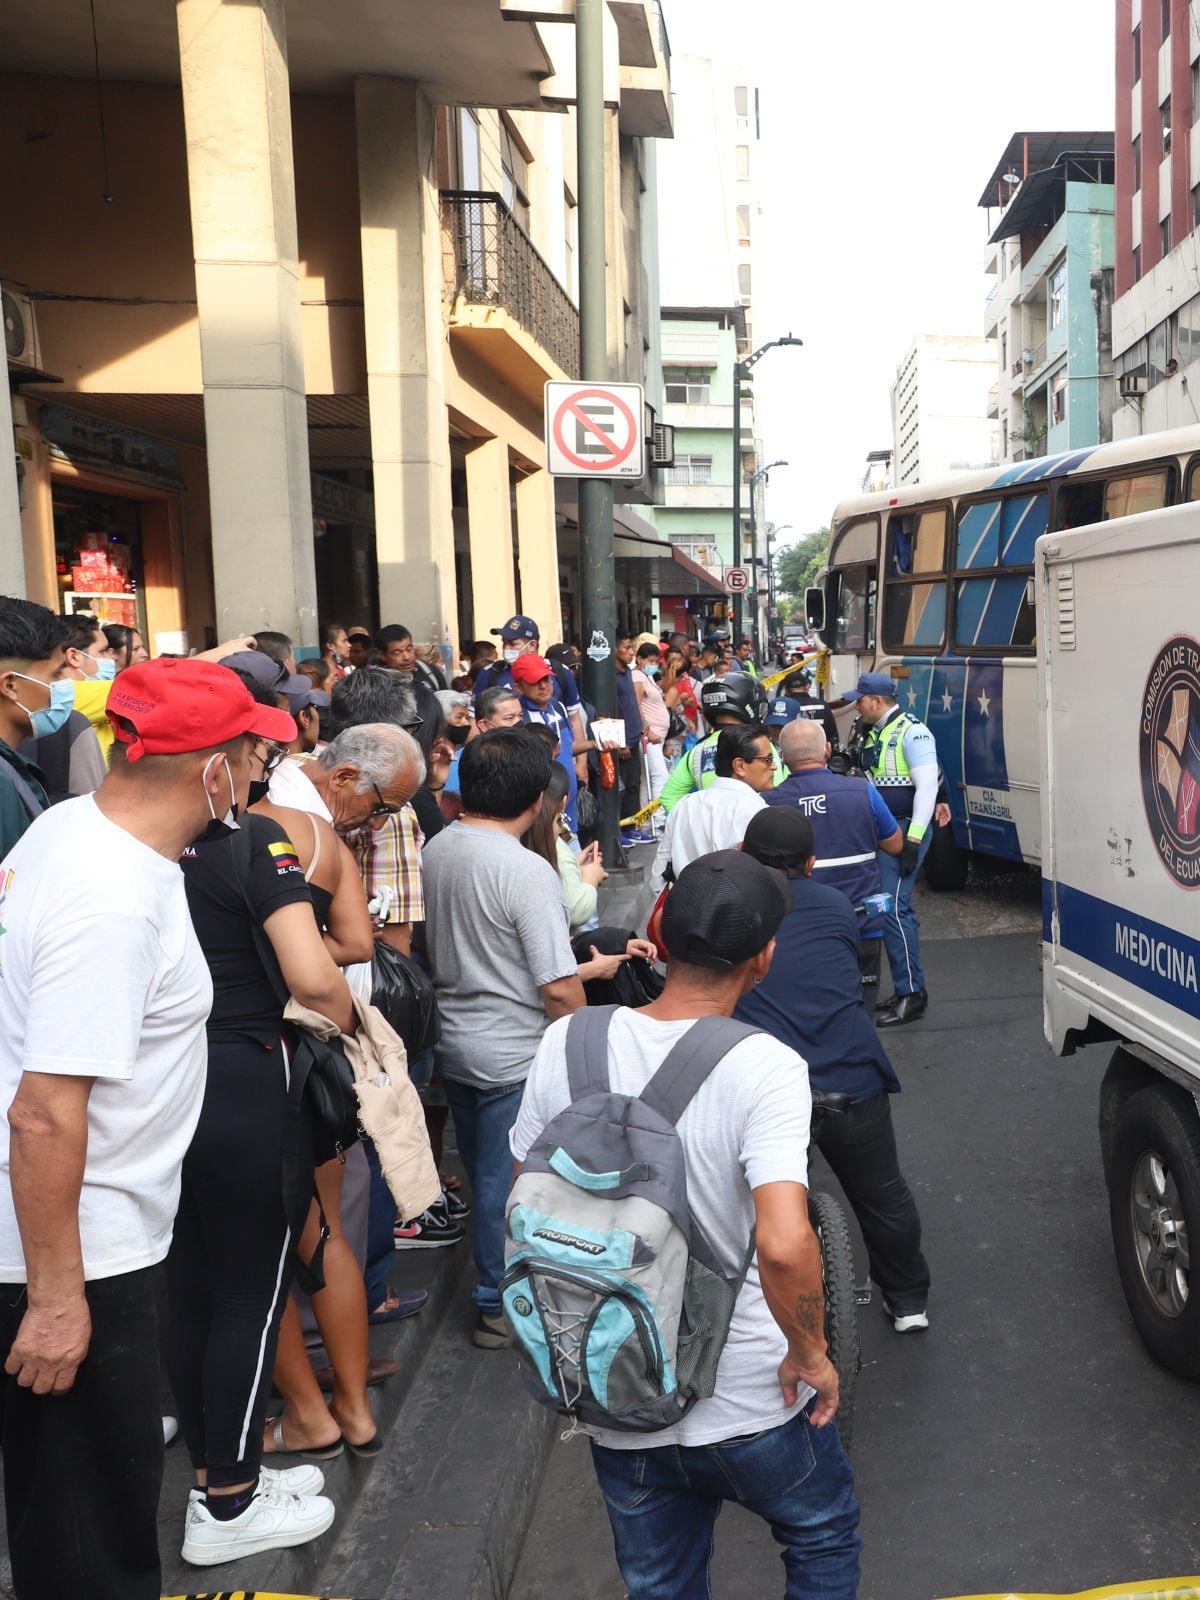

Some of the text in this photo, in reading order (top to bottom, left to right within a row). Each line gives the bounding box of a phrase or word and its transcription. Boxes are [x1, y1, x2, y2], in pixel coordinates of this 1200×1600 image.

[575, 404, 615, 455] E
[1143, 654, 1173, 735] COMISION
[1173, 646, 1186, 665] DE
[798, 794, 827, 817] TC
[970, 800, 1012, 819] TRANSABRIL
[1159, 834, 1176, 870] DEL
[1115, 922, 1198, 993] MEDICINA
